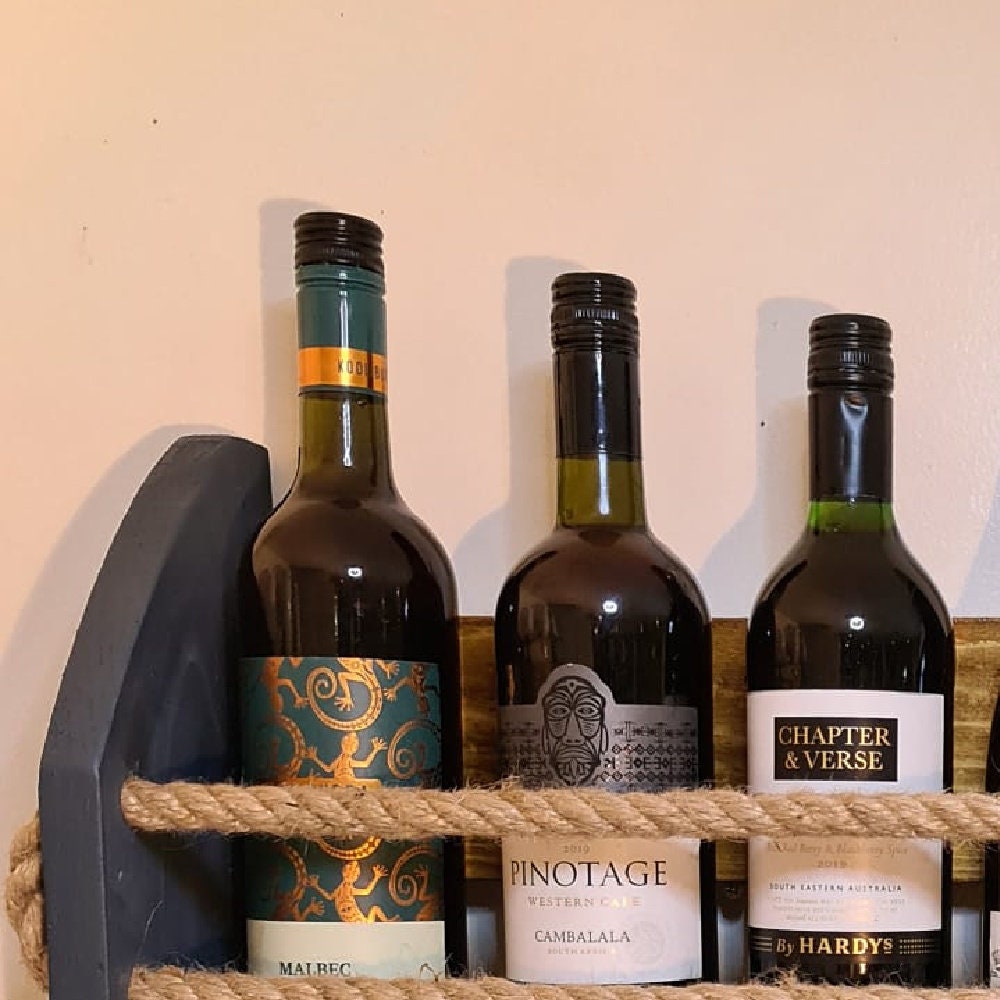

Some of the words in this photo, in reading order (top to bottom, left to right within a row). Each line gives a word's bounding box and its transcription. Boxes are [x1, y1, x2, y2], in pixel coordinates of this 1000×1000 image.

[778, 725, 892, 747] CHAPTER
[785, 751, 800, 769] &
[804, 750, 884, 770] VERSE
[511, 860, 667, 887] PINOTAGE
[527, 896, 594, 907] WESTERN
[534, 930, 631, 943] CAMBALALA
[776, 937, 795, 957] By
[279, 961, 351, 977] MALBEC
